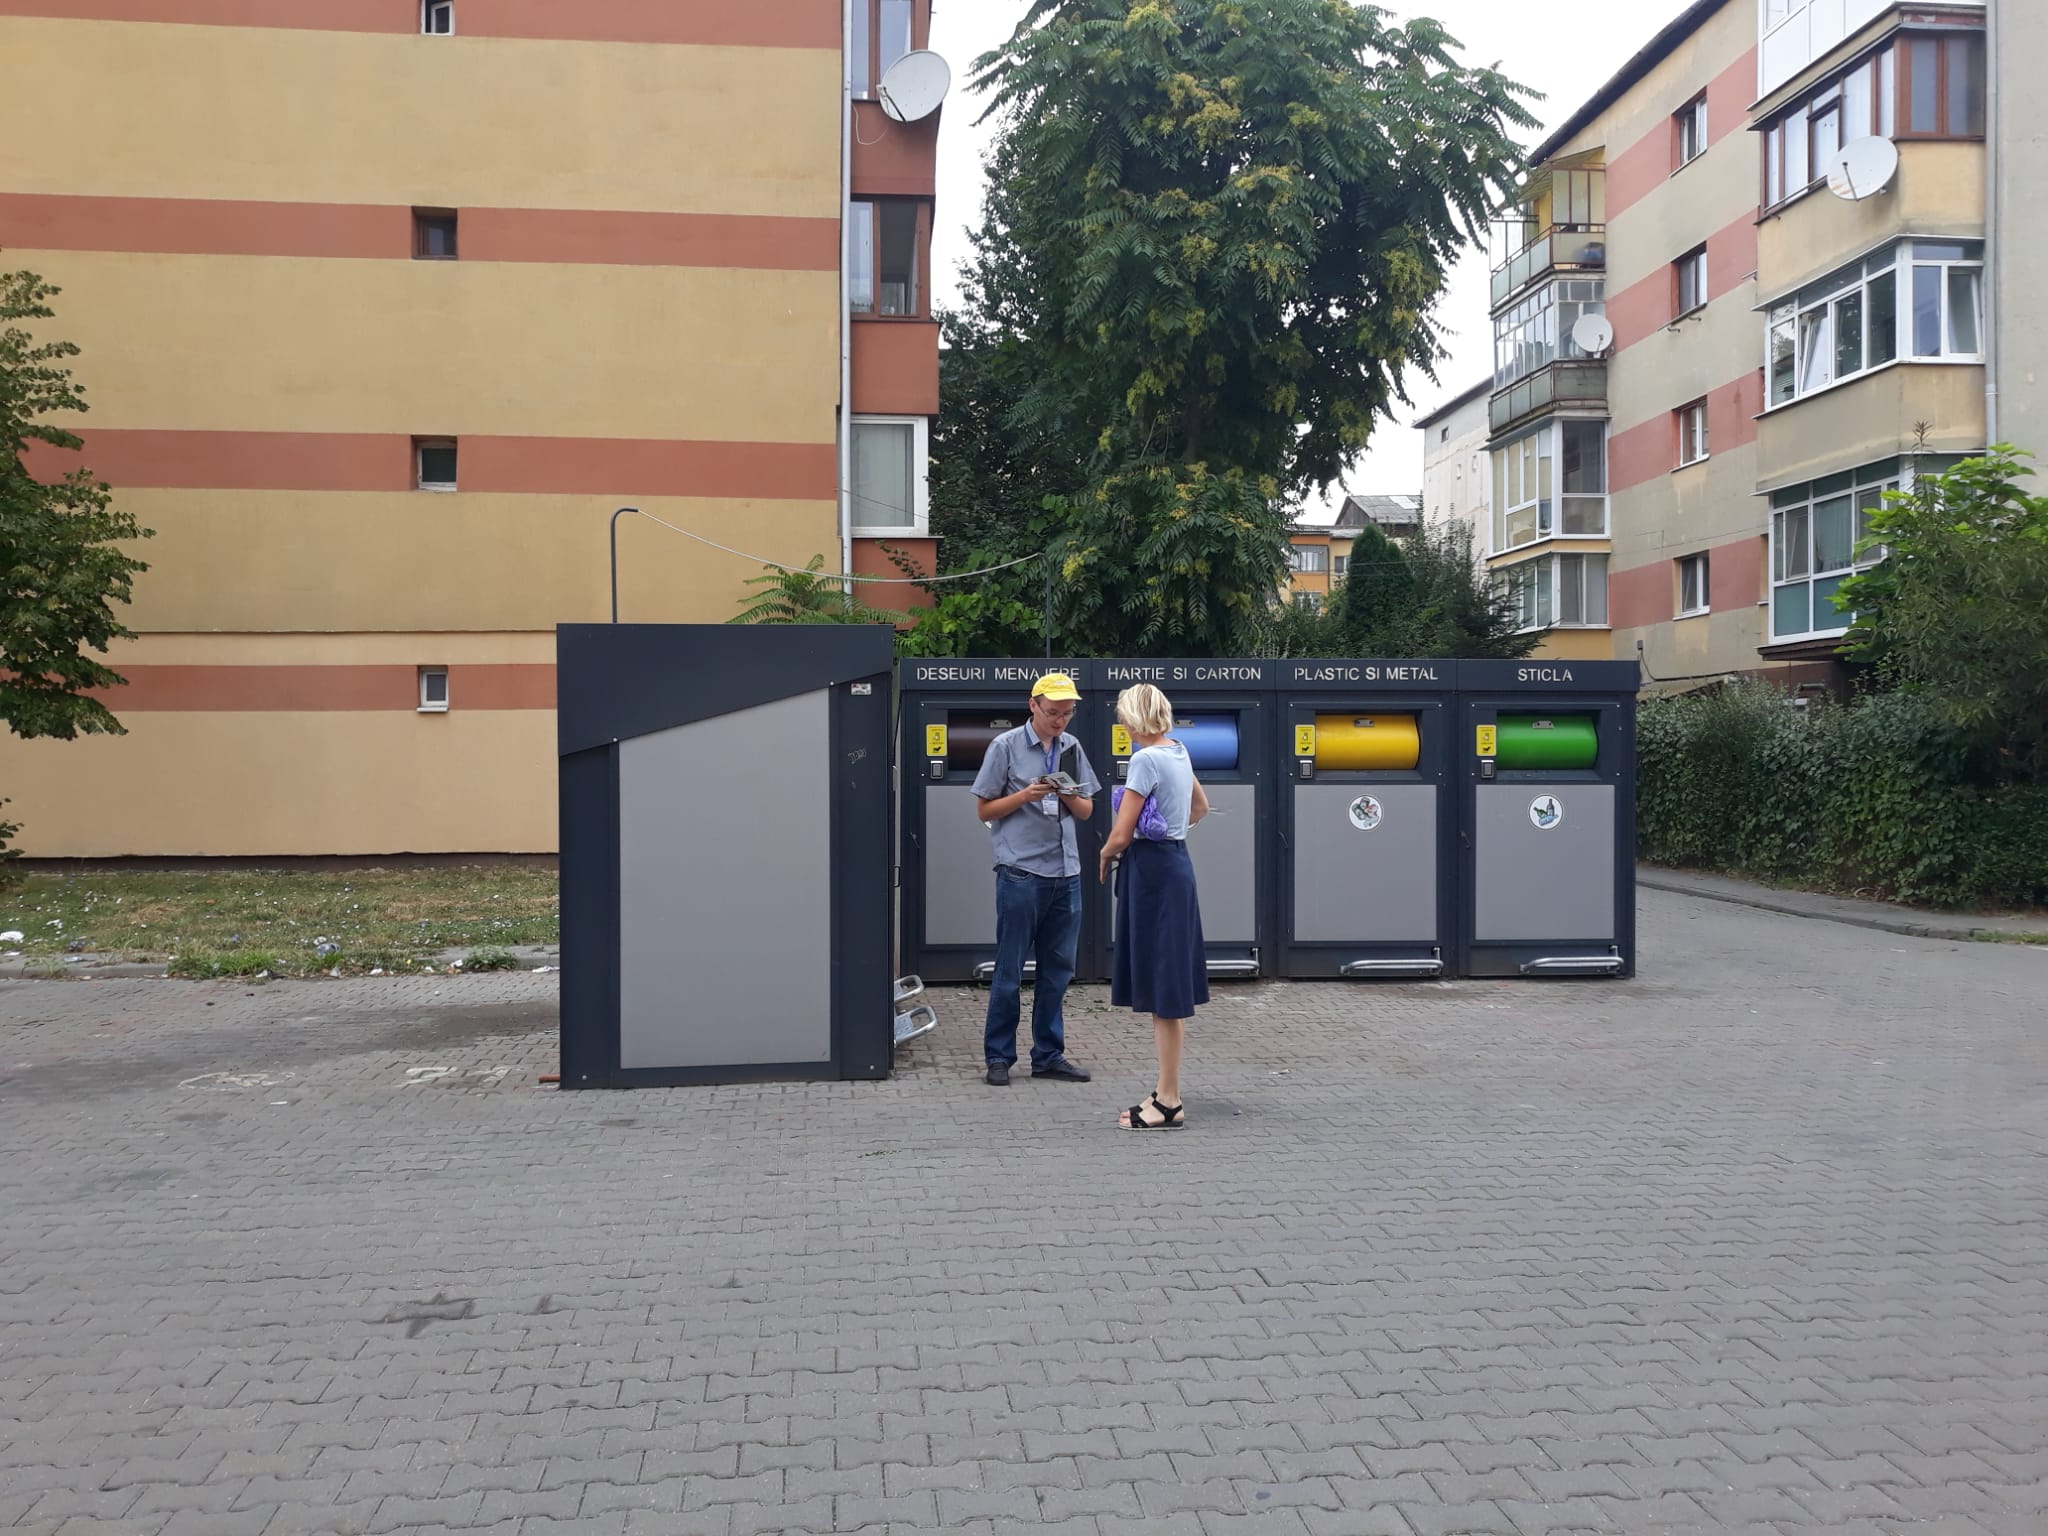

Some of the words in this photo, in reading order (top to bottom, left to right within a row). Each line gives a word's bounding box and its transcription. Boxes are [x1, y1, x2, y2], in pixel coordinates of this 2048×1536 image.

[916, 667, 985, 681] DESEURI
[1107, 667, 1166, 680] HARTIE
[1172, 667, 1188, 680] SI
[1195, 667, 1261, 680] CARTON
[1294, 667, 1360, 680] PLASTIC
[1365, 667, 1380, 680] SI
[1386, 667, 1439, 680] METAL
[1517, 668, 1573, 682] STICLA
